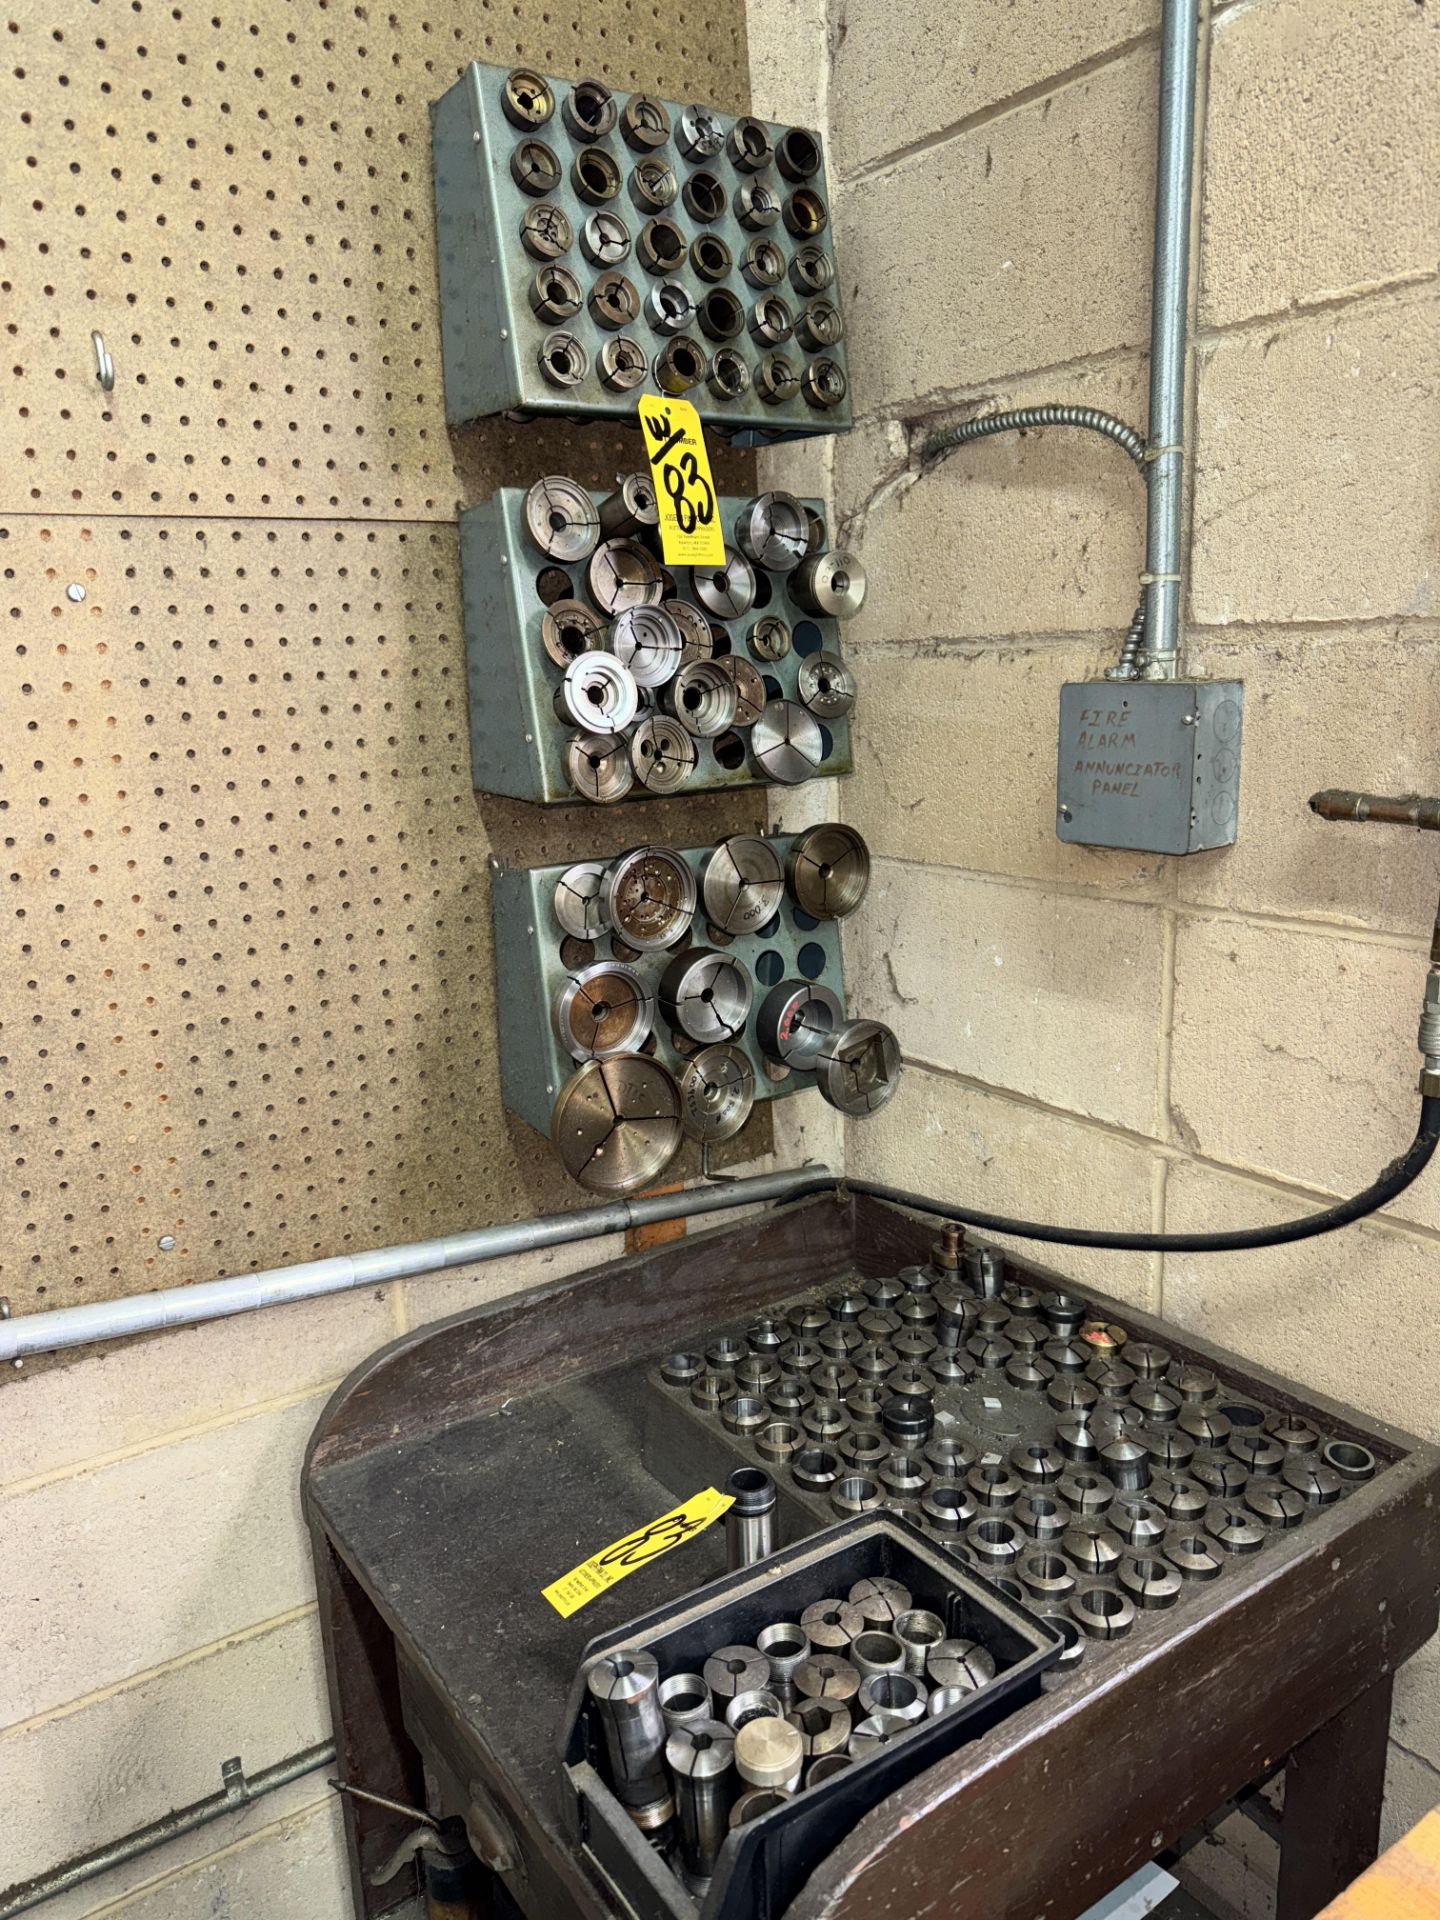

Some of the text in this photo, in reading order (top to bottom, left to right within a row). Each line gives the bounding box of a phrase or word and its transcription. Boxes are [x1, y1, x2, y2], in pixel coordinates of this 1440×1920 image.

[663, 452, 714, 534] 83
[1079, 709, 1132, 727] FIRE
[1077, 730, 1136, 751] ALARM
[1074, 760, 1182, 779] ANNUNCIATOR
[1092, 779, 1141, 797] PANEL
[599, 1513, 707, 1567] 83
